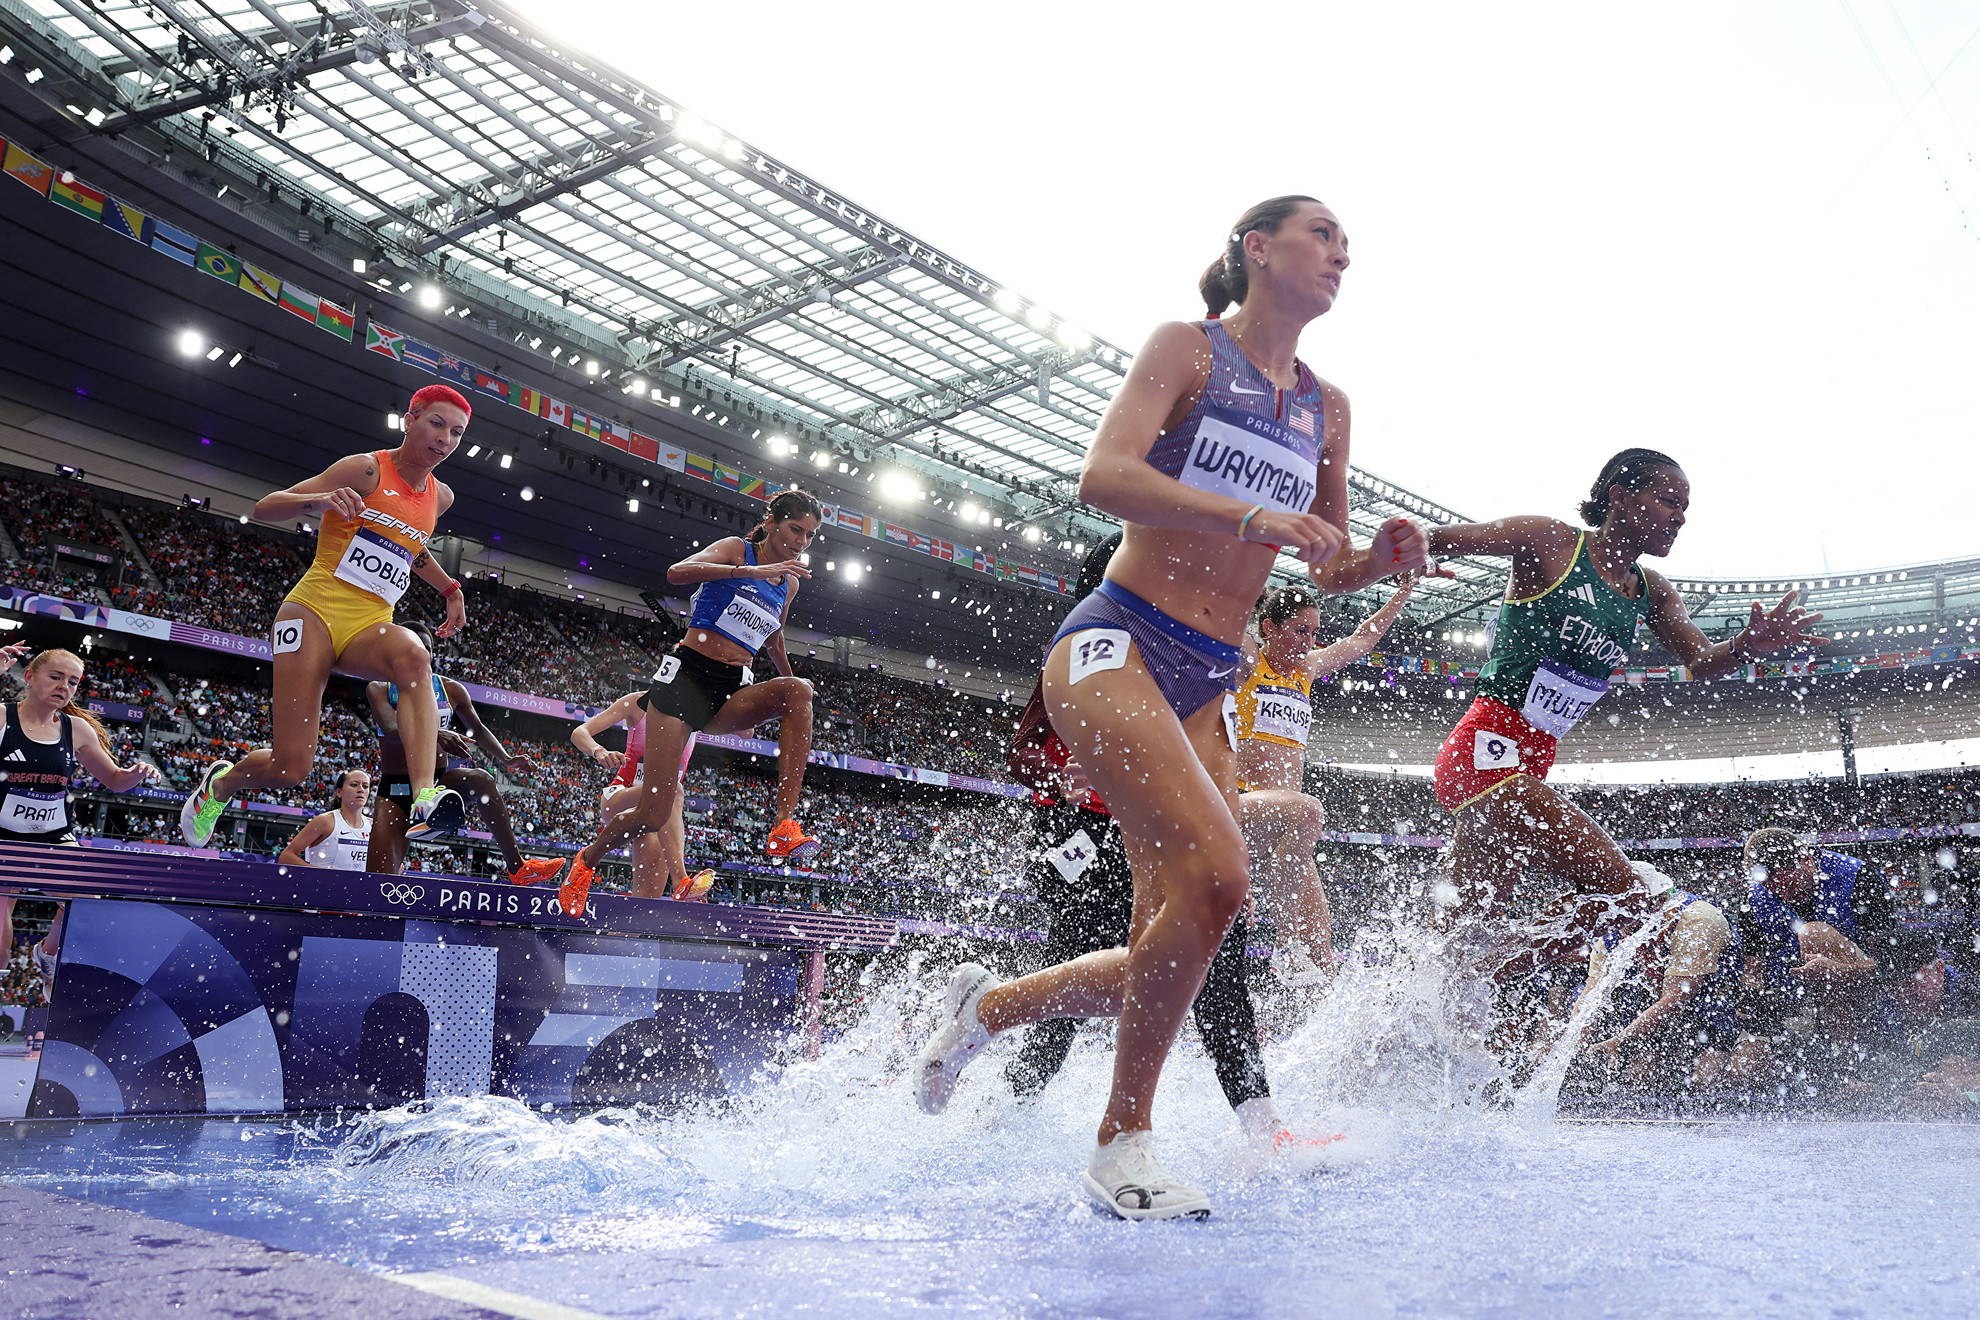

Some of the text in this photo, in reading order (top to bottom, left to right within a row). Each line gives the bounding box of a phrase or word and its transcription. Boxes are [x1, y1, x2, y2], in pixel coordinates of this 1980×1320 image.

[1246, 416, 1281, 438] PARIS
[1193, 436, 1314, 512] WAYMENT
[378, 538, 399, 552] PARIS
[348, 546, 410, 591] ROBLES
[202, 633, 245, 651] PARIS
[276, 626, 298, 647] 10
[1078, 638, 1115, 667] 12
[660, 661, 672, 677] 5
[485, 690, 551, 712] PARIS 2024
[127, 709, 144, 719] E13
[708, 734, 763, 750] PARIS 2024
[1487, 739, 1507, 761] 9
[7, 772, 40, 784] GREAT
[962, 779, 985, 791] PARIS
[142, 789, 167, 799] PARIS
[350, 850, 368, 862] YEE
[439, 889, 597, 921] PARIS 204
